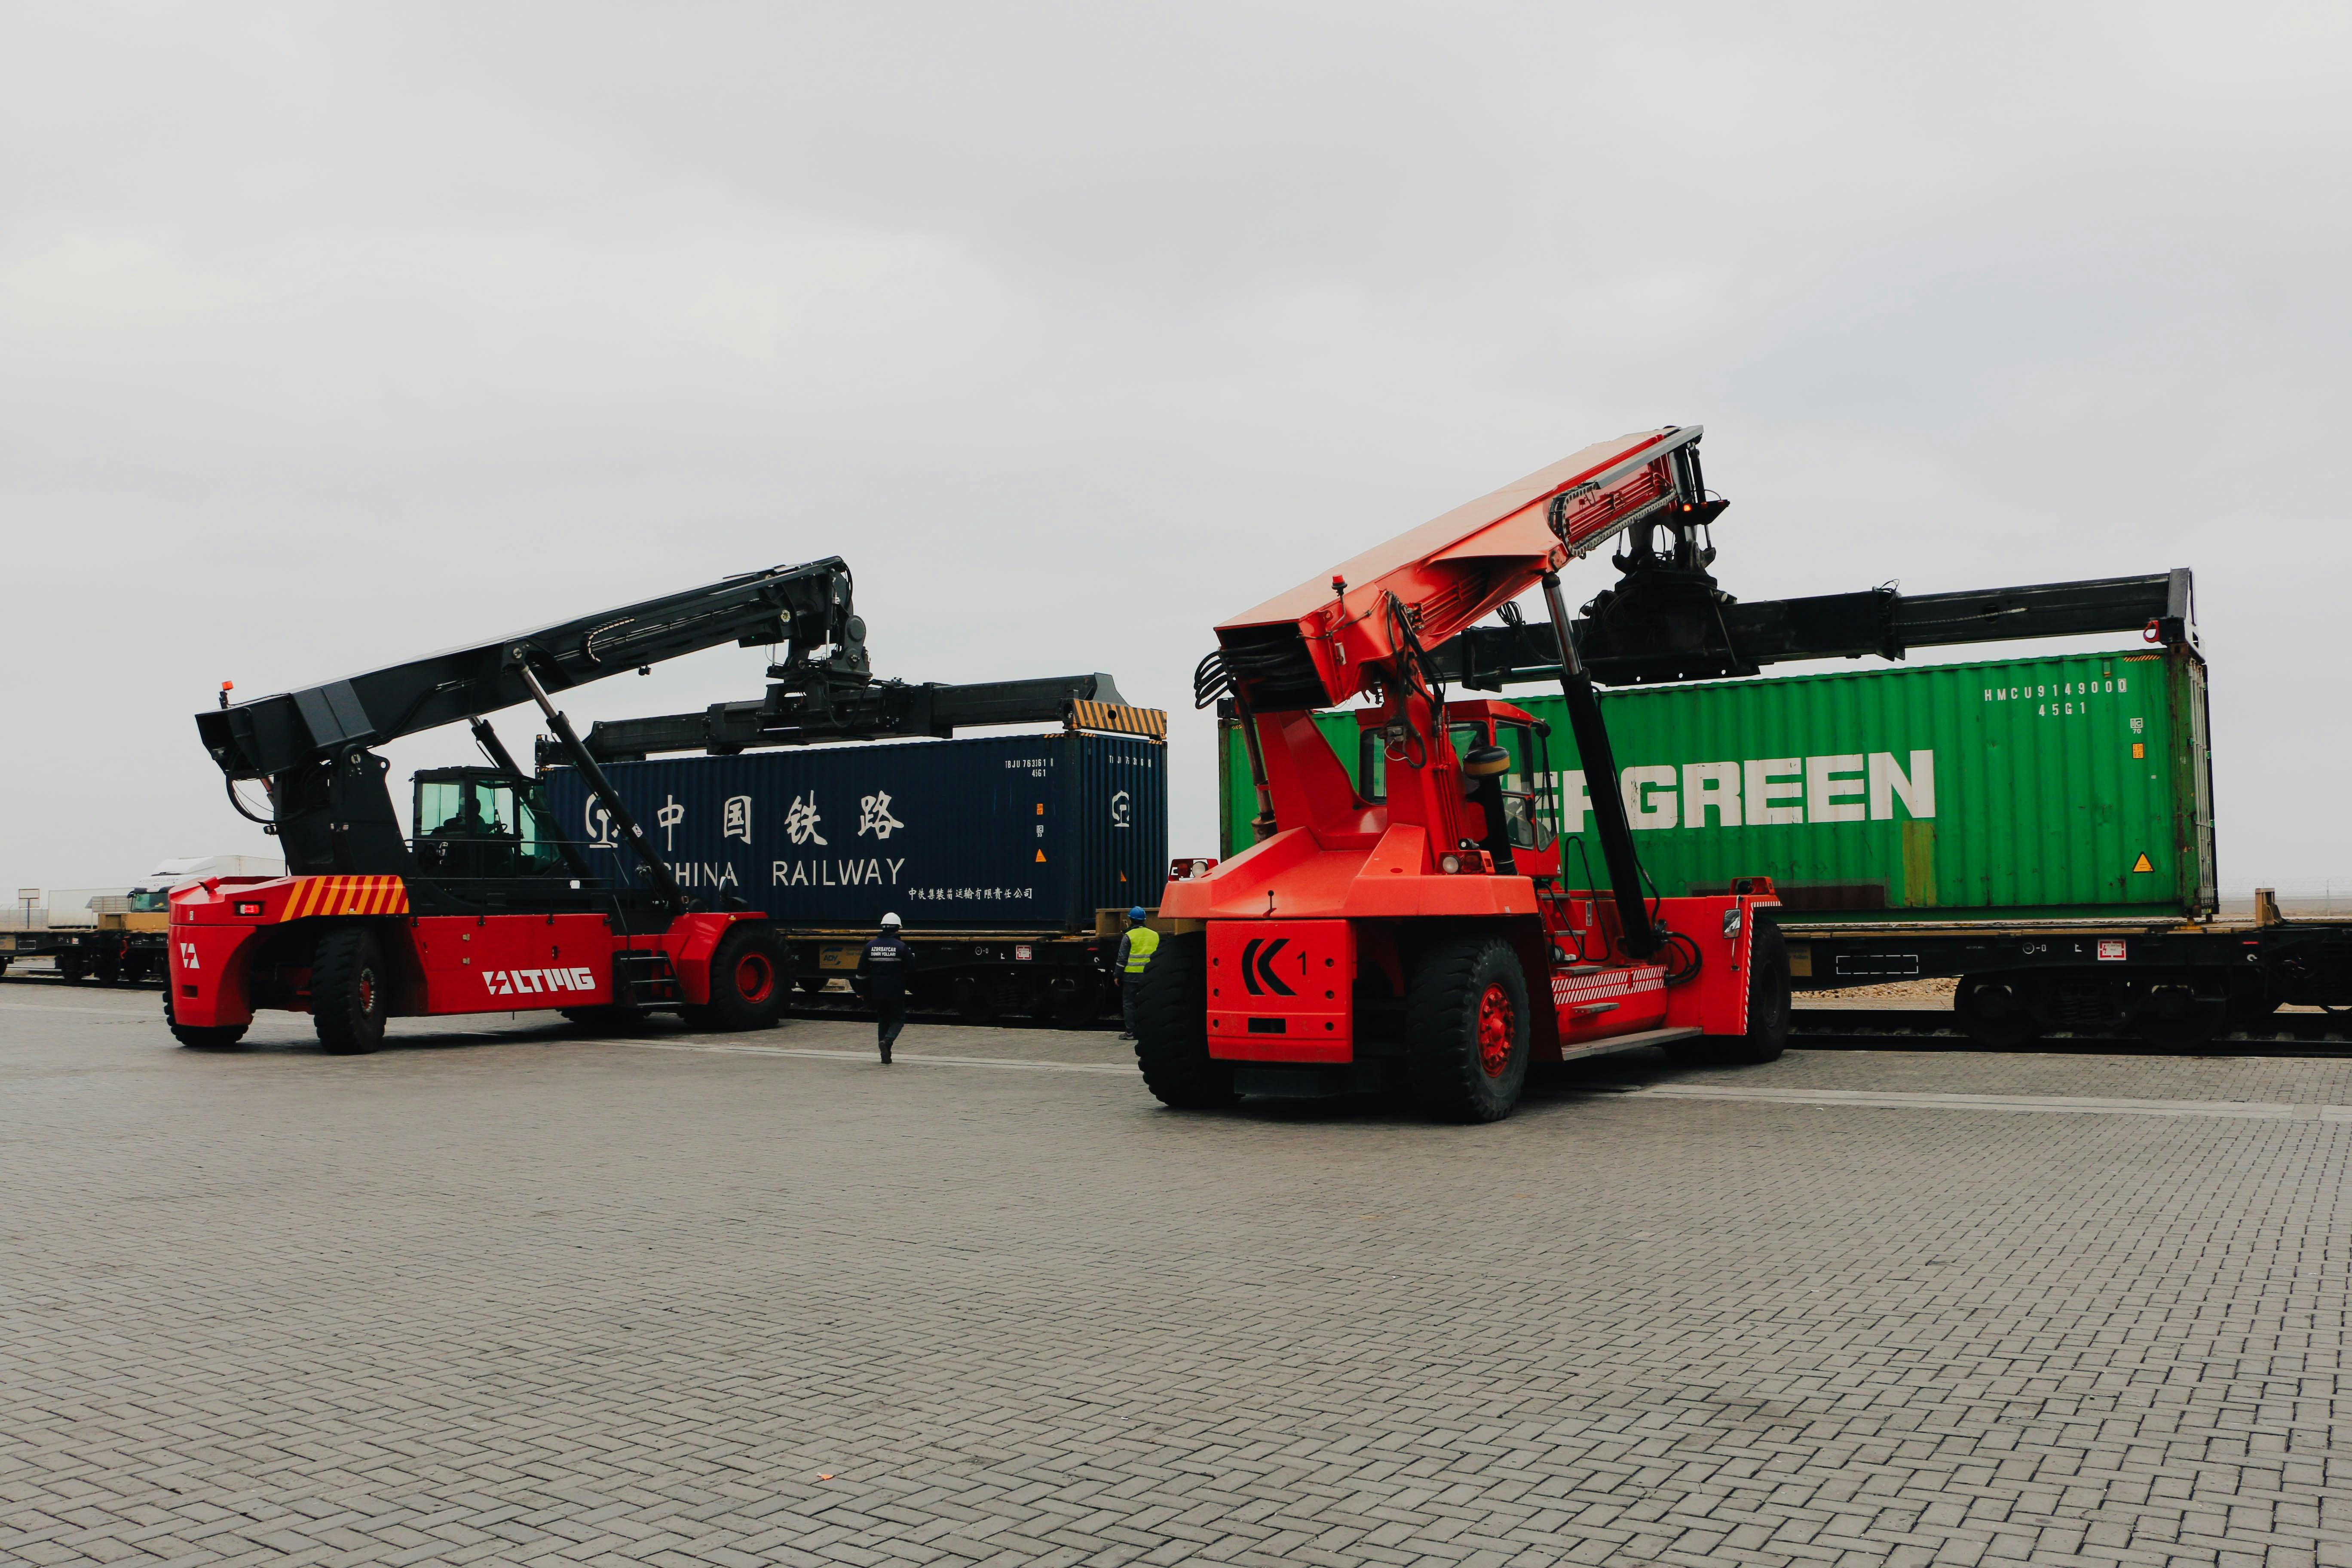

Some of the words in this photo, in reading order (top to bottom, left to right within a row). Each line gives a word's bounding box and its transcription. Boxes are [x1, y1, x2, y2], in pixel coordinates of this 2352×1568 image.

[2039, 702, 2085, 716] 45G1
[1023, 759, 1045, 767] 763361
[1032, 769, 1045, 777] 45G1
[1500, 750, 1935, 833] EGREEN
[658, 790, 904, 851] 中国铁路
[664, 862, 738, 886] HINA
[773, 858, 905, 886] RAILWAY
[1297, 951, 1307, 976] 1
